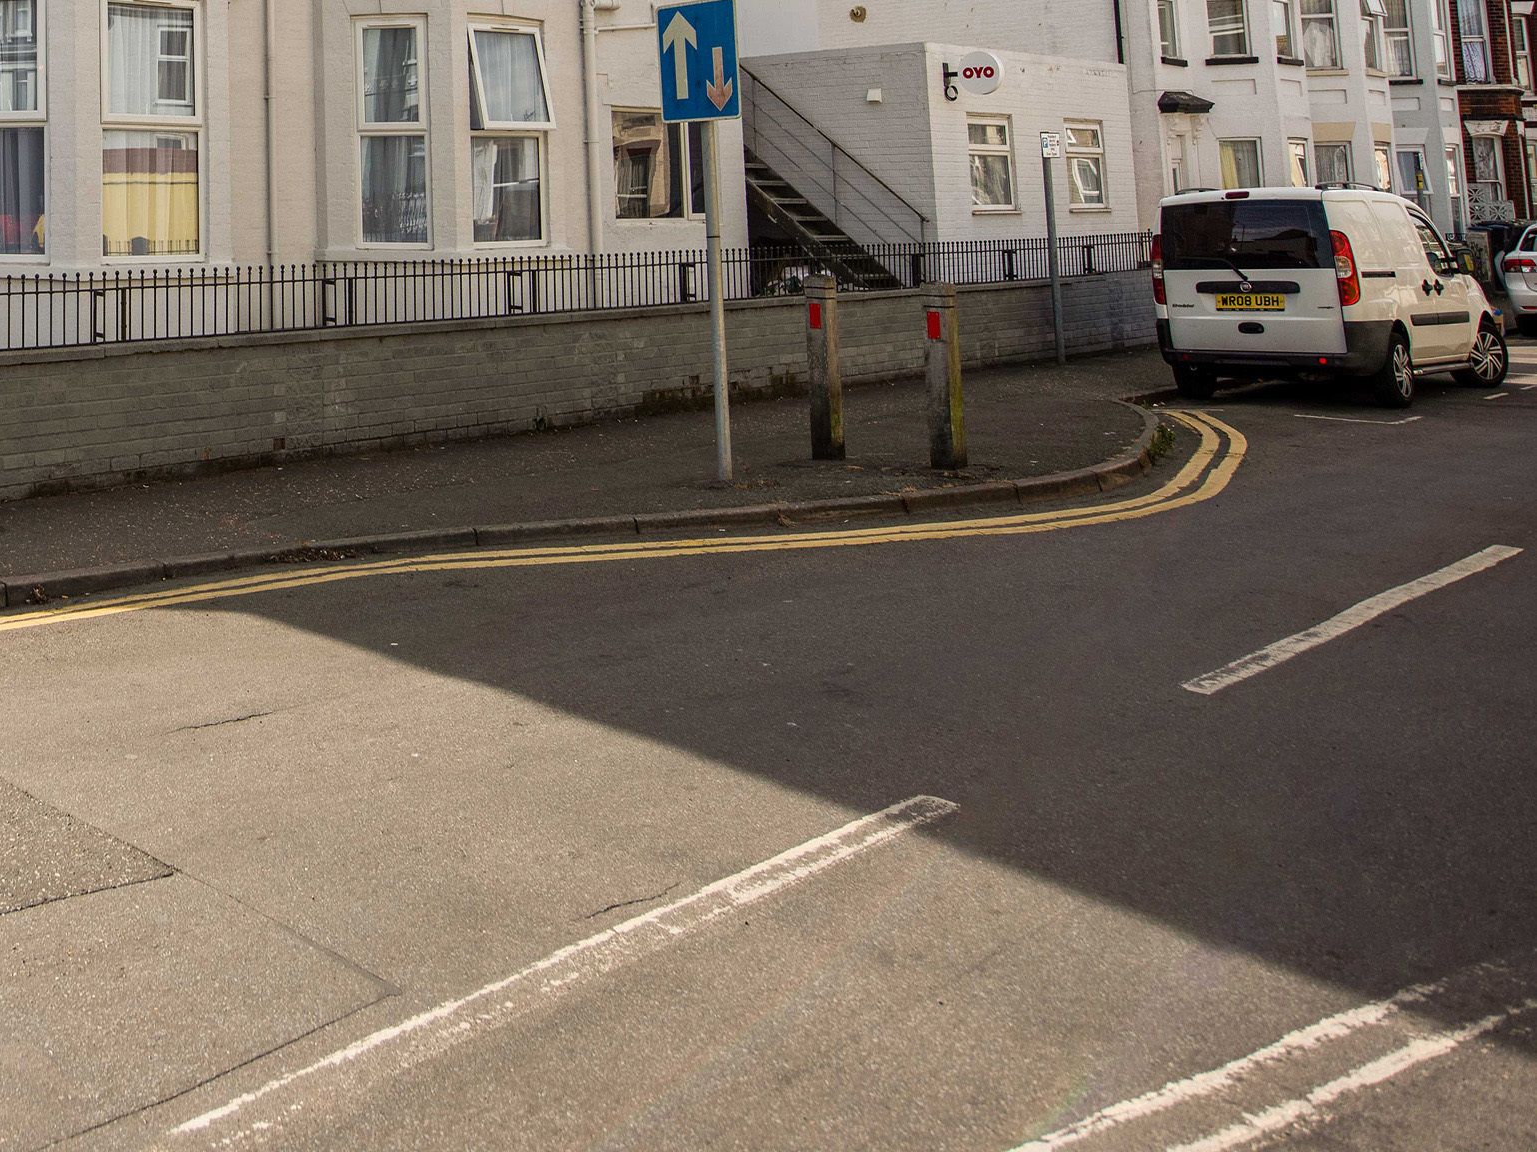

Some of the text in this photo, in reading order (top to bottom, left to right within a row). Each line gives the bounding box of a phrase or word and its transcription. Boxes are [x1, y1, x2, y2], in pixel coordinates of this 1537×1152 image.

[962, 66, 995, 80] OYO
[1221, 295, 1279, 306] WR08 UBH
